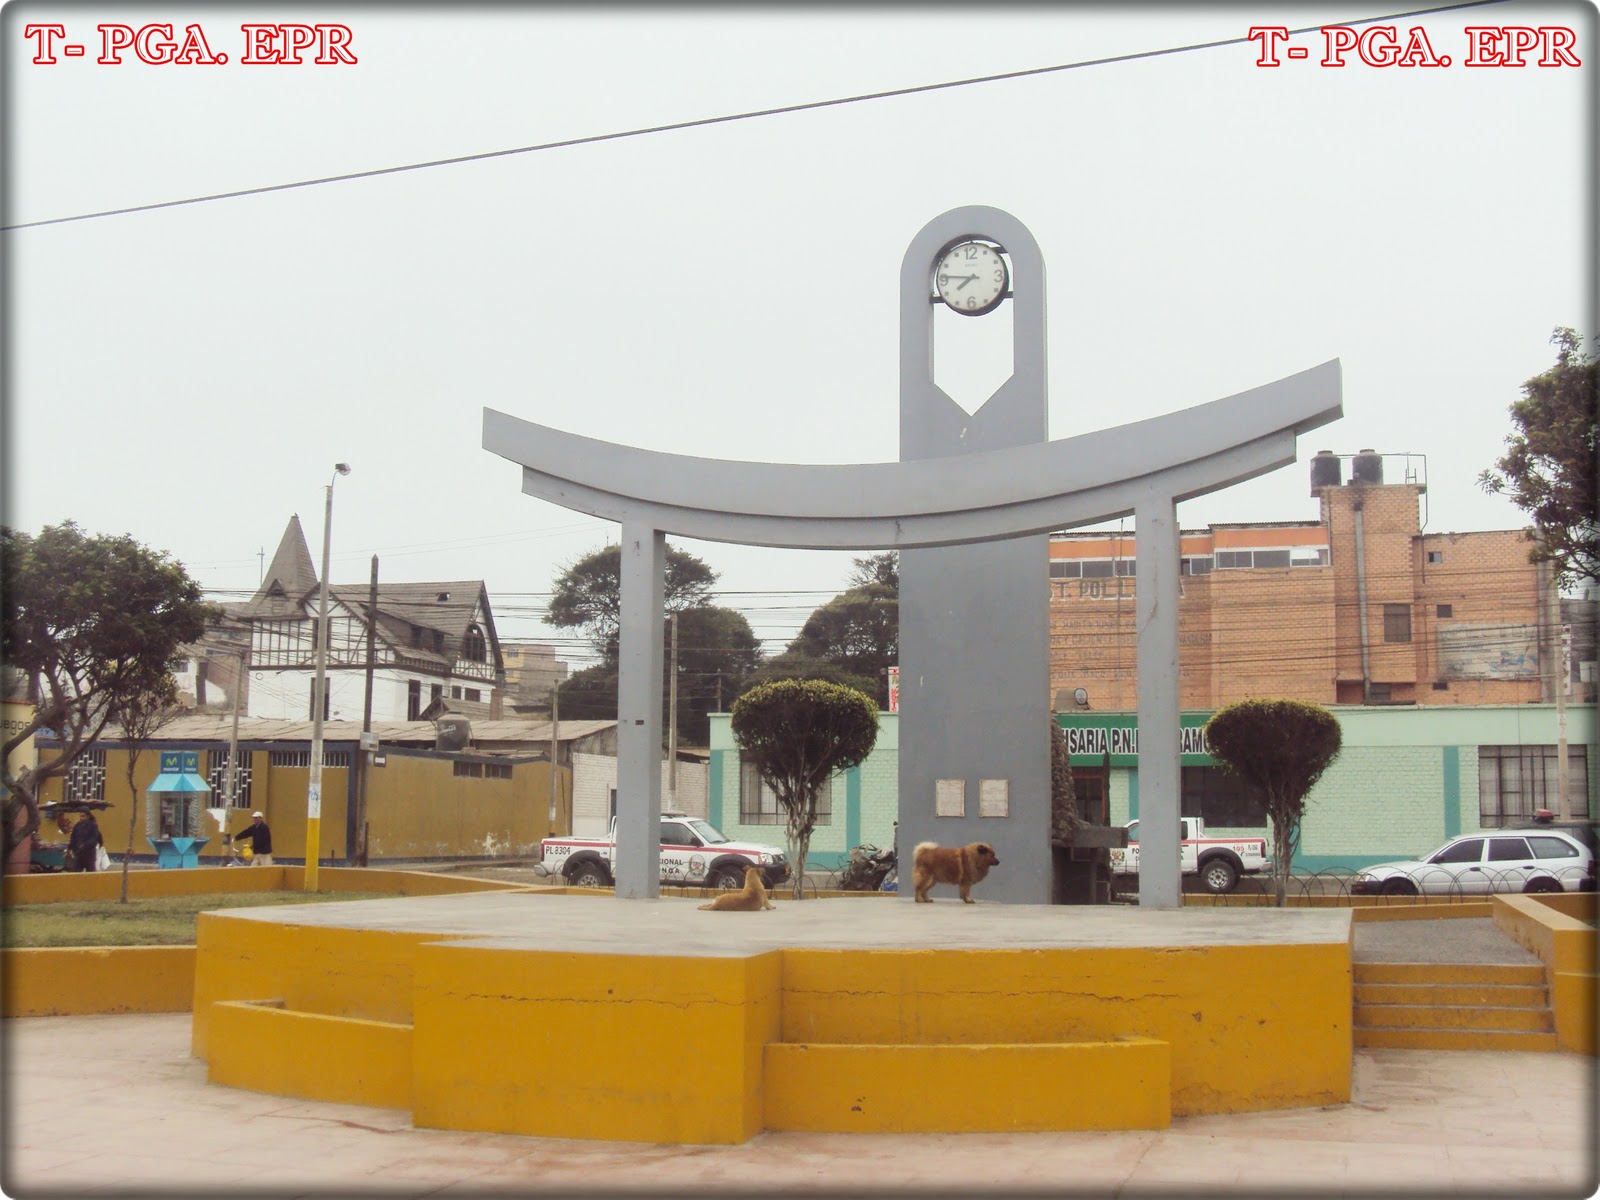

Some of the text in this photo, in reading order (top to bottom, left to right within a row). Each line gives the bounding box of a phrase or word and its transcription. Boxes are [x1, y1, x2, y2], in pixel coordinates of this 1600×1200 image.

[964, 247, 978, 260] 12
[940, 274, 949, 286] 9
[994, 270, 1003, 282] 3
[967, 297, 976, 309] 6
[1062, 727, 1110, 755] ISARIA
[660, 858, 683, 866] IONAL
